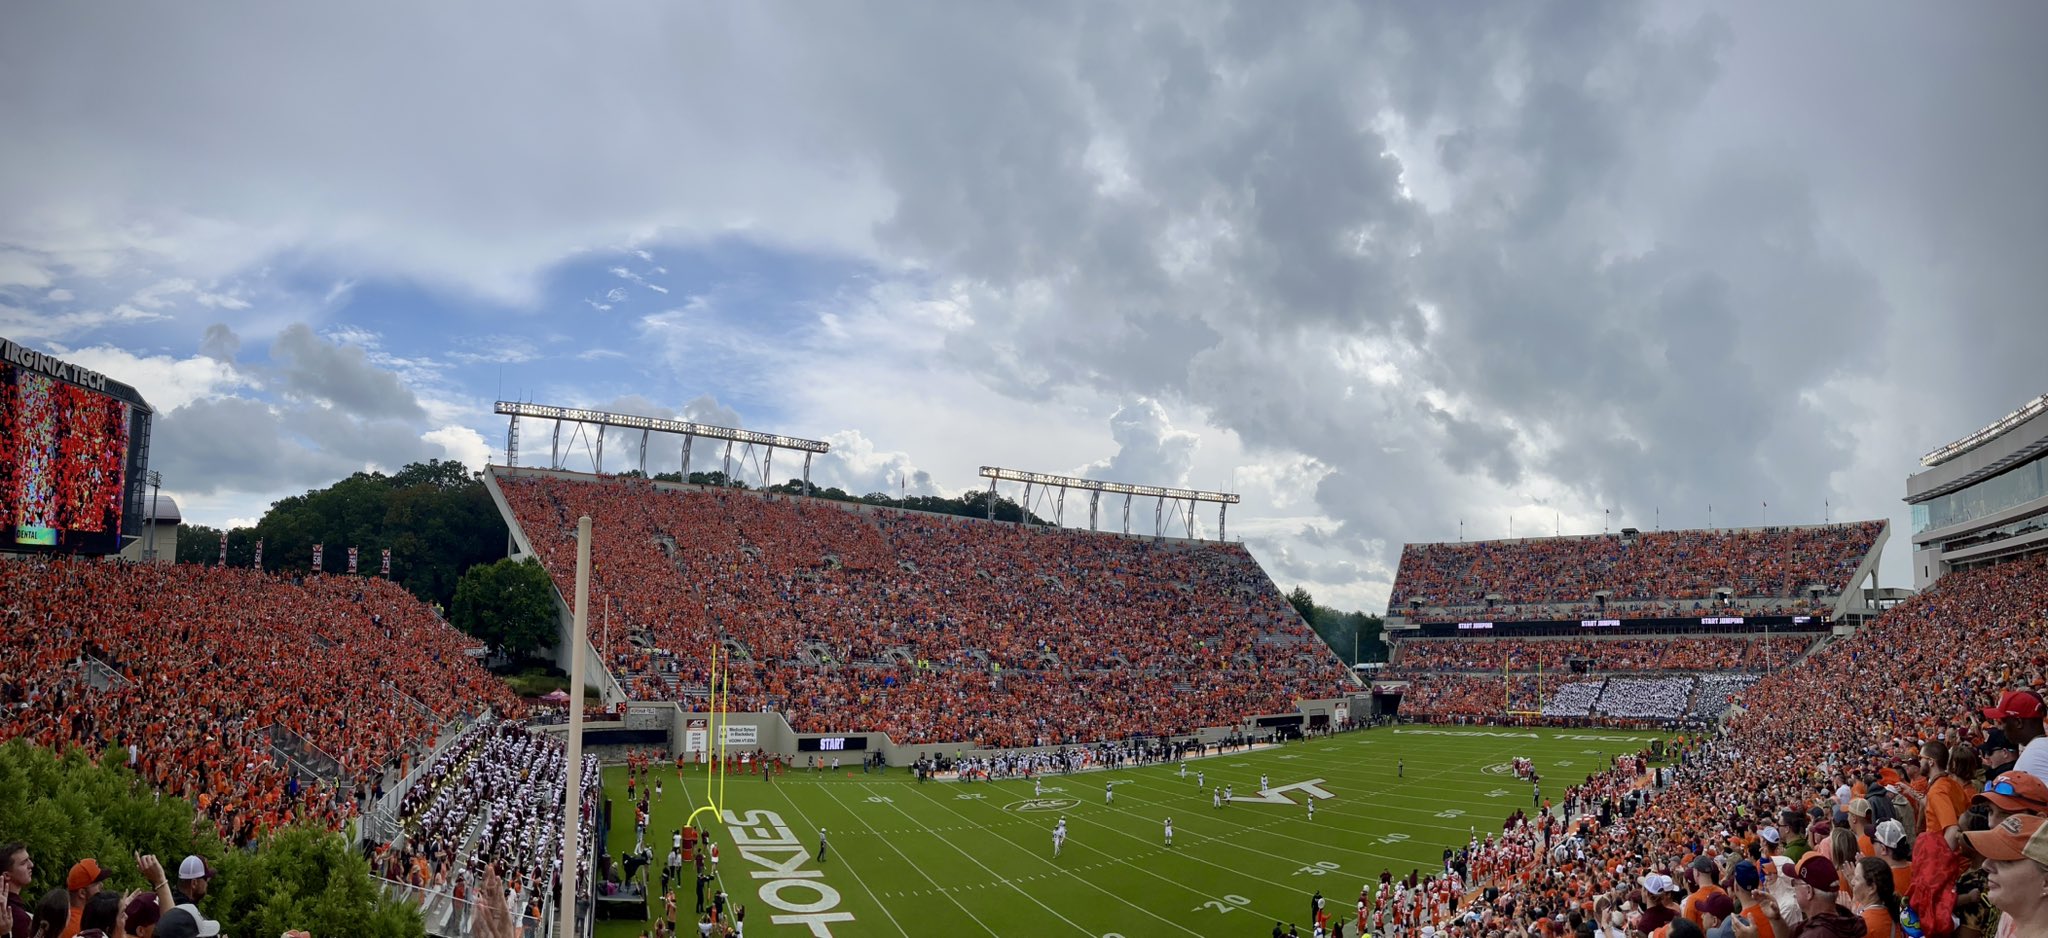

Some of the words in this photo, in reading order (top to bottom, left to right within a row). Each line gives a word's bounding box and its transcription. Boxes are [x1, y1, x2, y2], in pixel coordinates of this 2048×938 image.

[72, 364, 106, 391] TECH
[17, 530, 38, 539] DENTAL
[820, 738, 845, 750] START
[1434, 809, 1466, 819] 50
[1378, 832, 1411, 845] 40
[1301, 861, 1341, 876] 30
[1204, 894, 1251, 914] 20
